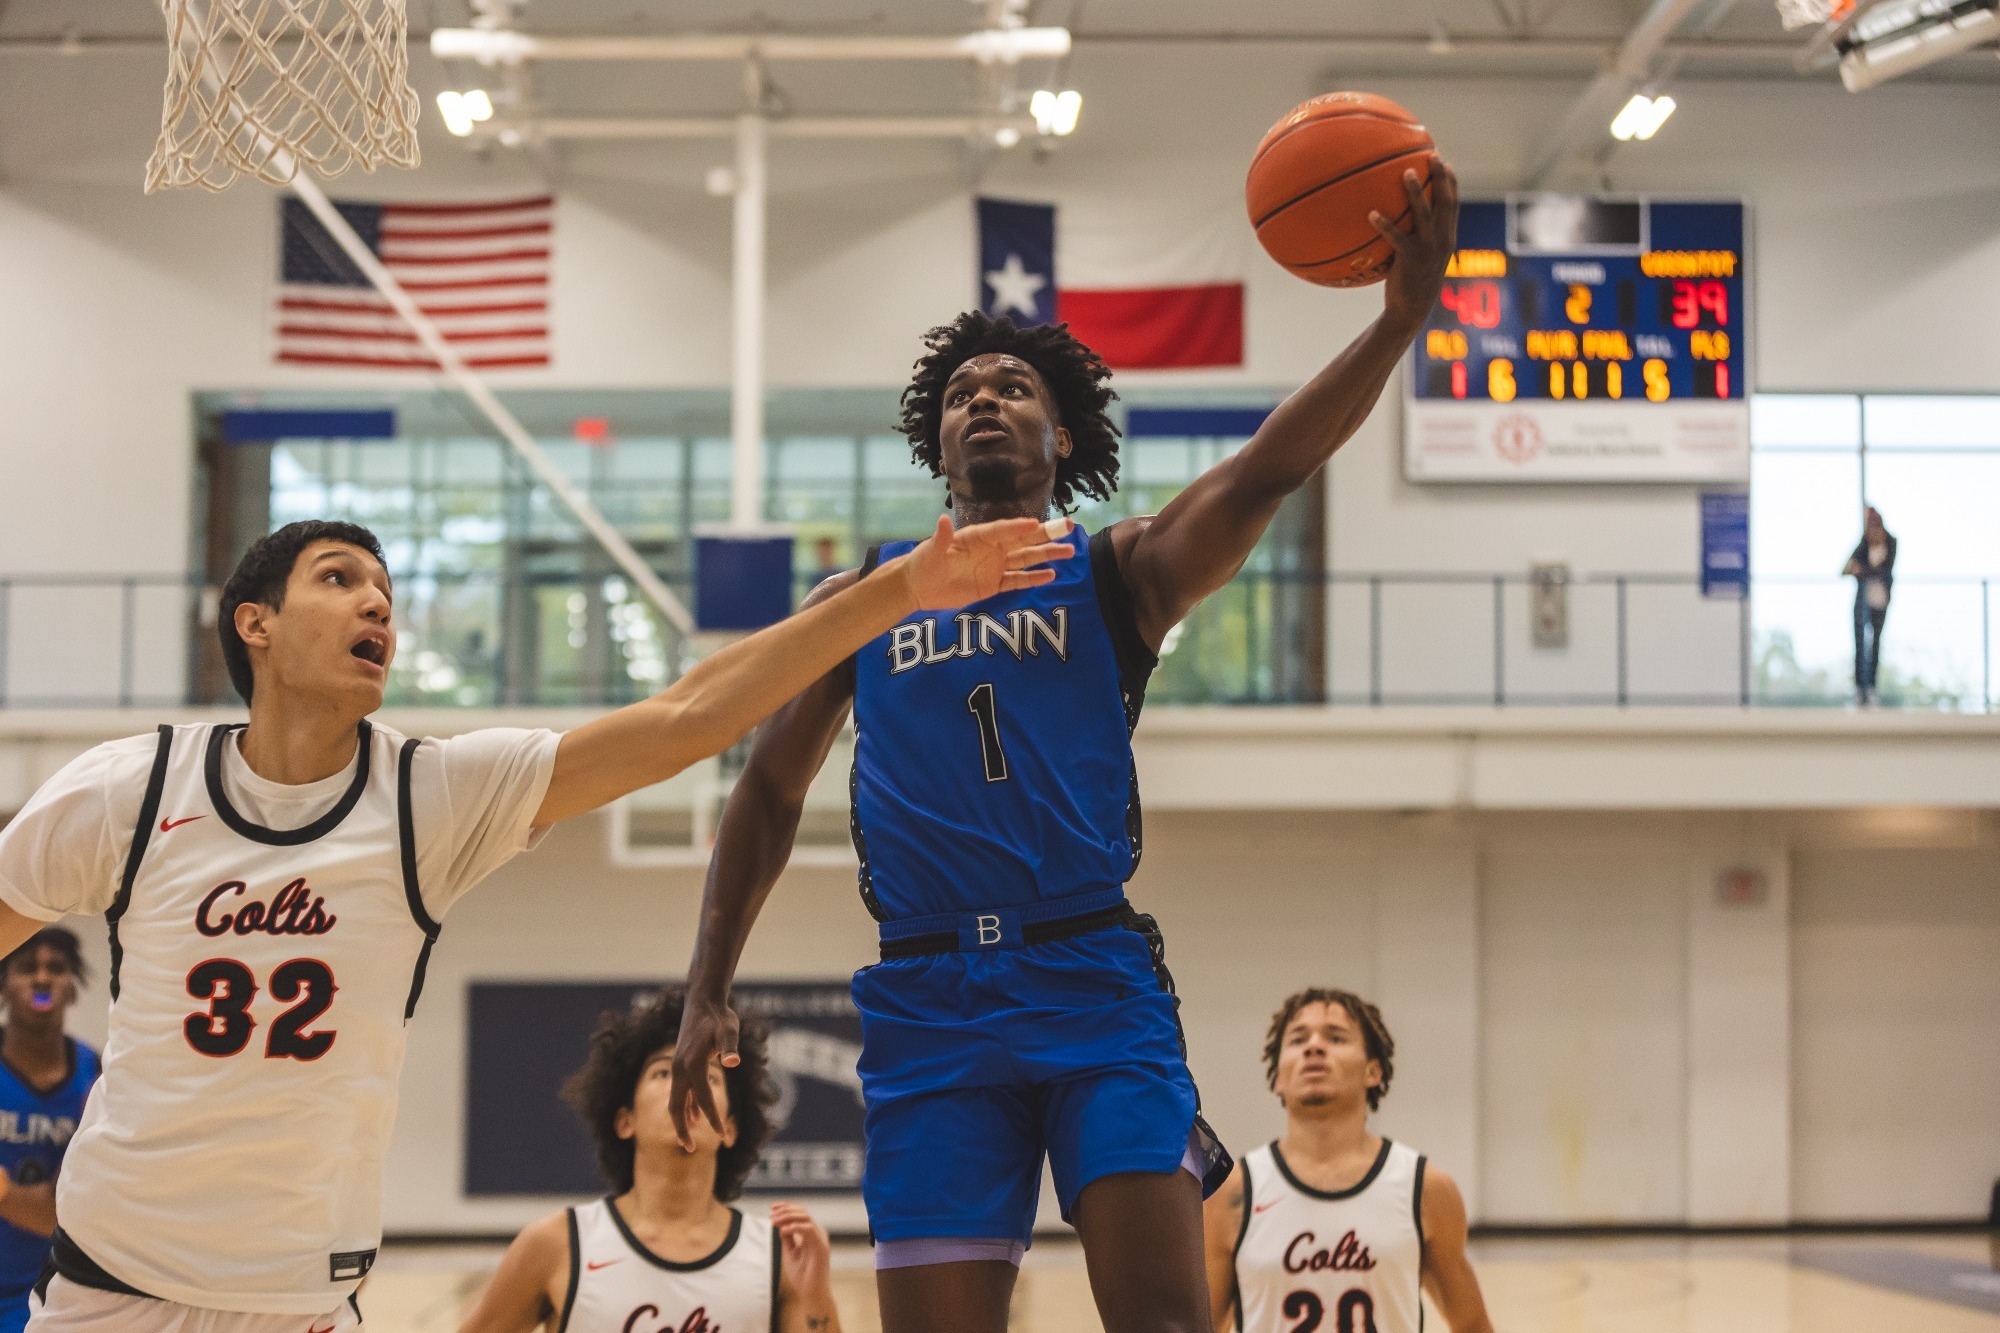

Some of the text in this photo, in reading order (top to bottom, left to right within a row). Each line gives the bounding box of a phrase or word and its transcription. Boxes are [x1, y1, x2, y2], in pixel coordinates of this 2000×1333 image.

[1440, 281, 1501, 328] 40
[1672, 279, 1728, 328] 39
[1451, 360, 1467, 399] 1
[1488, 358, 1517, 402] 6
[1715, 360, 1729, 399] 1
[887, 606, 1067, 675] BLINN
[967, 683, 1008, 782] 1
[195, 877, 337, 937] Colts
[976, 914, 1002, 946] B
[183, 957, 340, 1062] 32
[1283, 1228, 1377, 1274] Colts
[1283, 1288, 1378, 1333] 20
